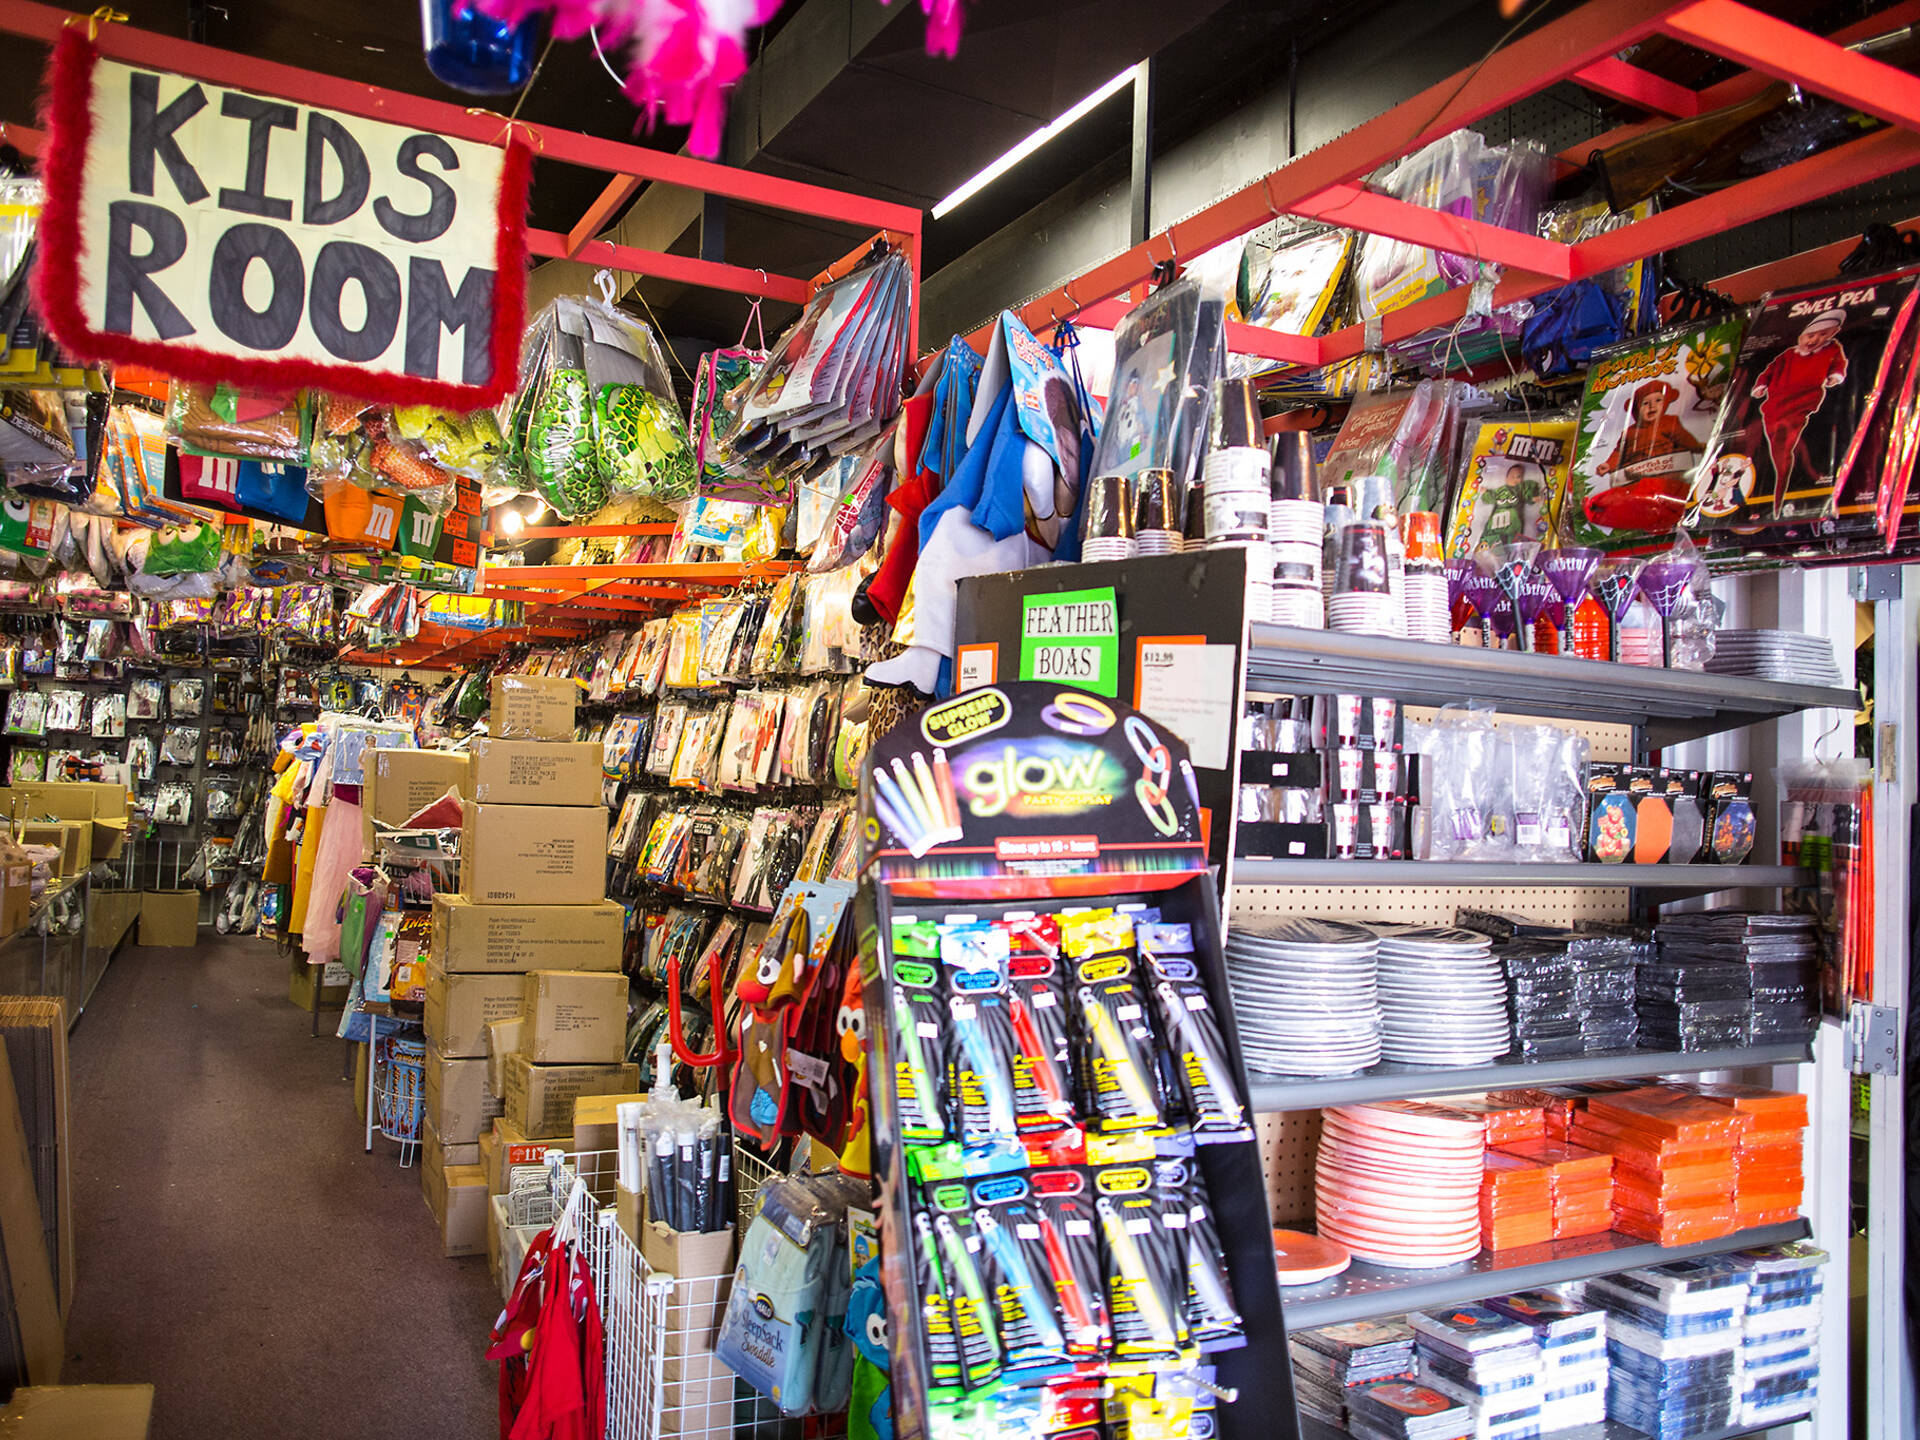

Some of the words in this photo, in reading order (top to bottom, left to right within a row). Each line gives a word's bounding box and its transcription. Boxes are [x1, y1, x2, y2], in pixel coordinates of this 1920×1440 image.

[129, 71, 460, 244] KIDS
[104, 200, 498, 386] ROOM
[1591, 359, 1678, 394] Monkeys
[1598, 347, 1656, 378] Barrel
[10, 415, 42, 438] DESERT
[364, 503, 395, 541] m
[411, 510, 436, 548] m
[1026, 601, 1114, 635] FEATHER
[1039, 646, 1092, 677] BOAS
[928, 694, 1000, 731] SUPREME
[946, 712, 991, 738] GLOW
[965, 746, 1105, 817] glow
[757, 1301, 772, 1319] HALO
[741, 1331, 776, 1368] Swaddle
